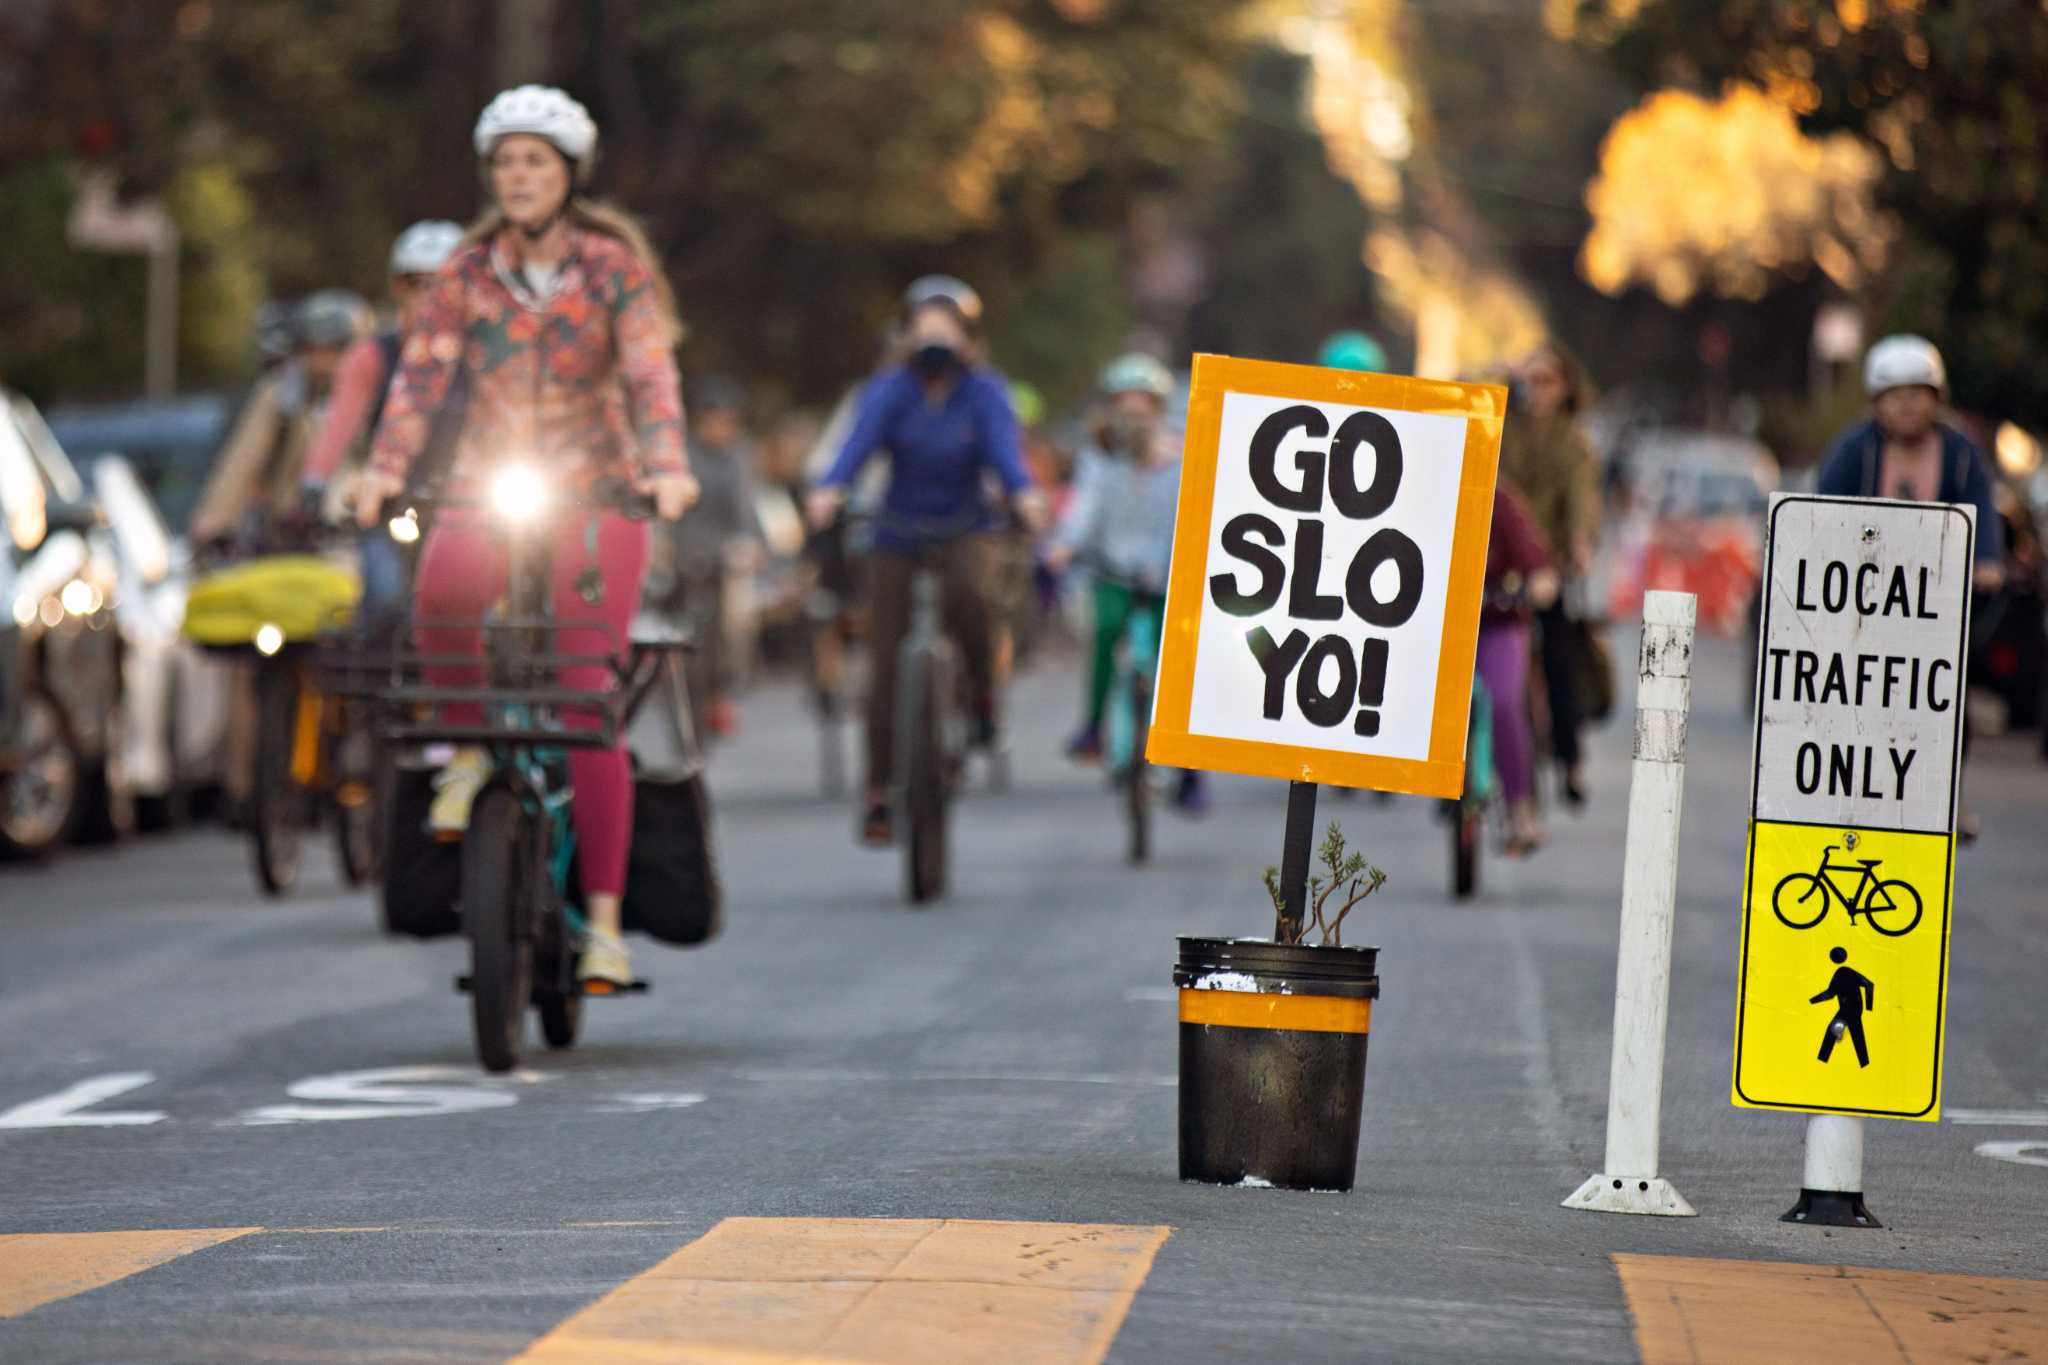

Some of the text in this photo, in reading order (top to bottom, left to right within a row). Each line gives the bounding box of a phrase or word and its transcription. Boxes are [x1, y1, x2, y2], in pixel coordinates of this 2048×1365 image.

[1248, 405, 1403, 520] GO
[1209, 513, 1424, 628] SLO
[1796, 558, 1939, 620] LOCAL
[1246, 625, 1389, 737] YO!
[1769, 648, 1952, 713] TRAFFIC
[1795, 741, 1917, 801] ONLY
